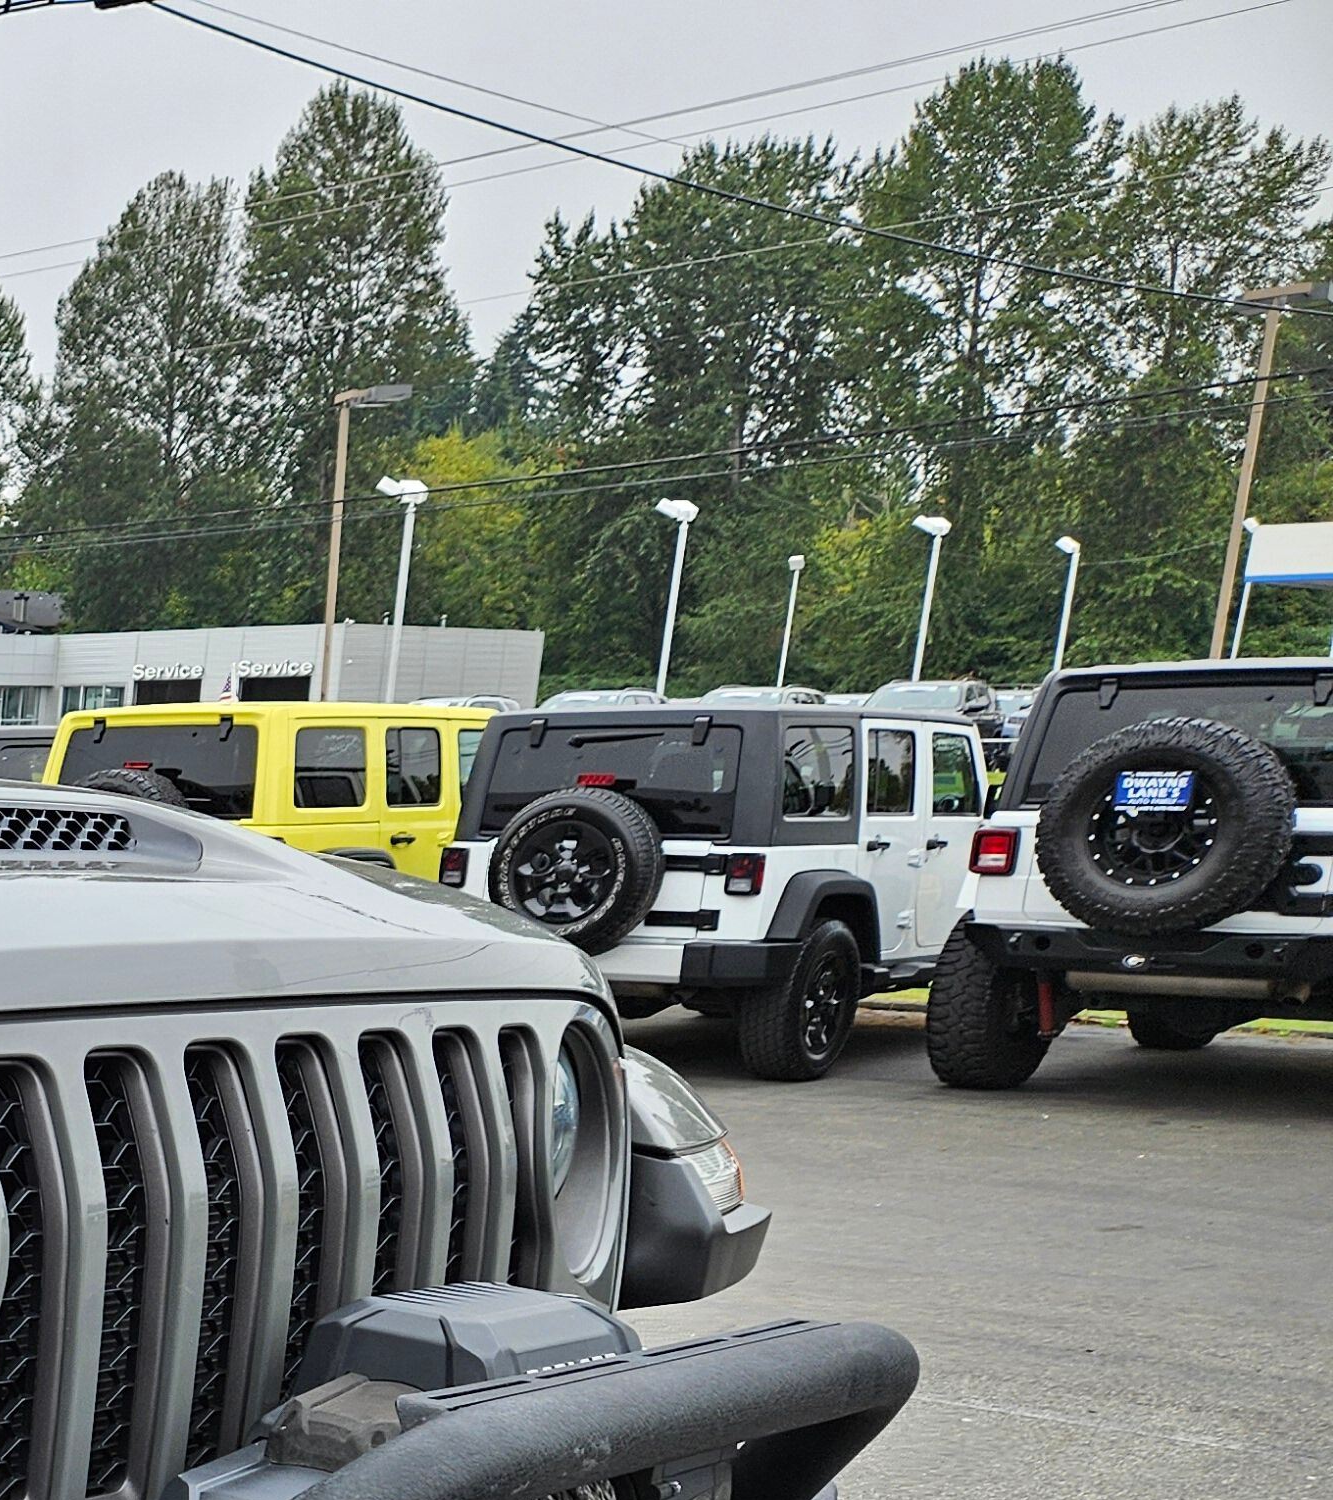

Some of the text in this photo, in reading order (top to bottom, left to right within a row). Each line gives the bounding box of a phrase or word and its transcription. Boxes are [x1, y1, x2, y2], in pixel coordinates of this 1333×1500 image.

[132, 661, 205, 681] Service
[237, 658, 314, 678] Service
[1122, 777, 1190, 788] DWAYNE
[1127, 788, 1181, 798] LANE'S
